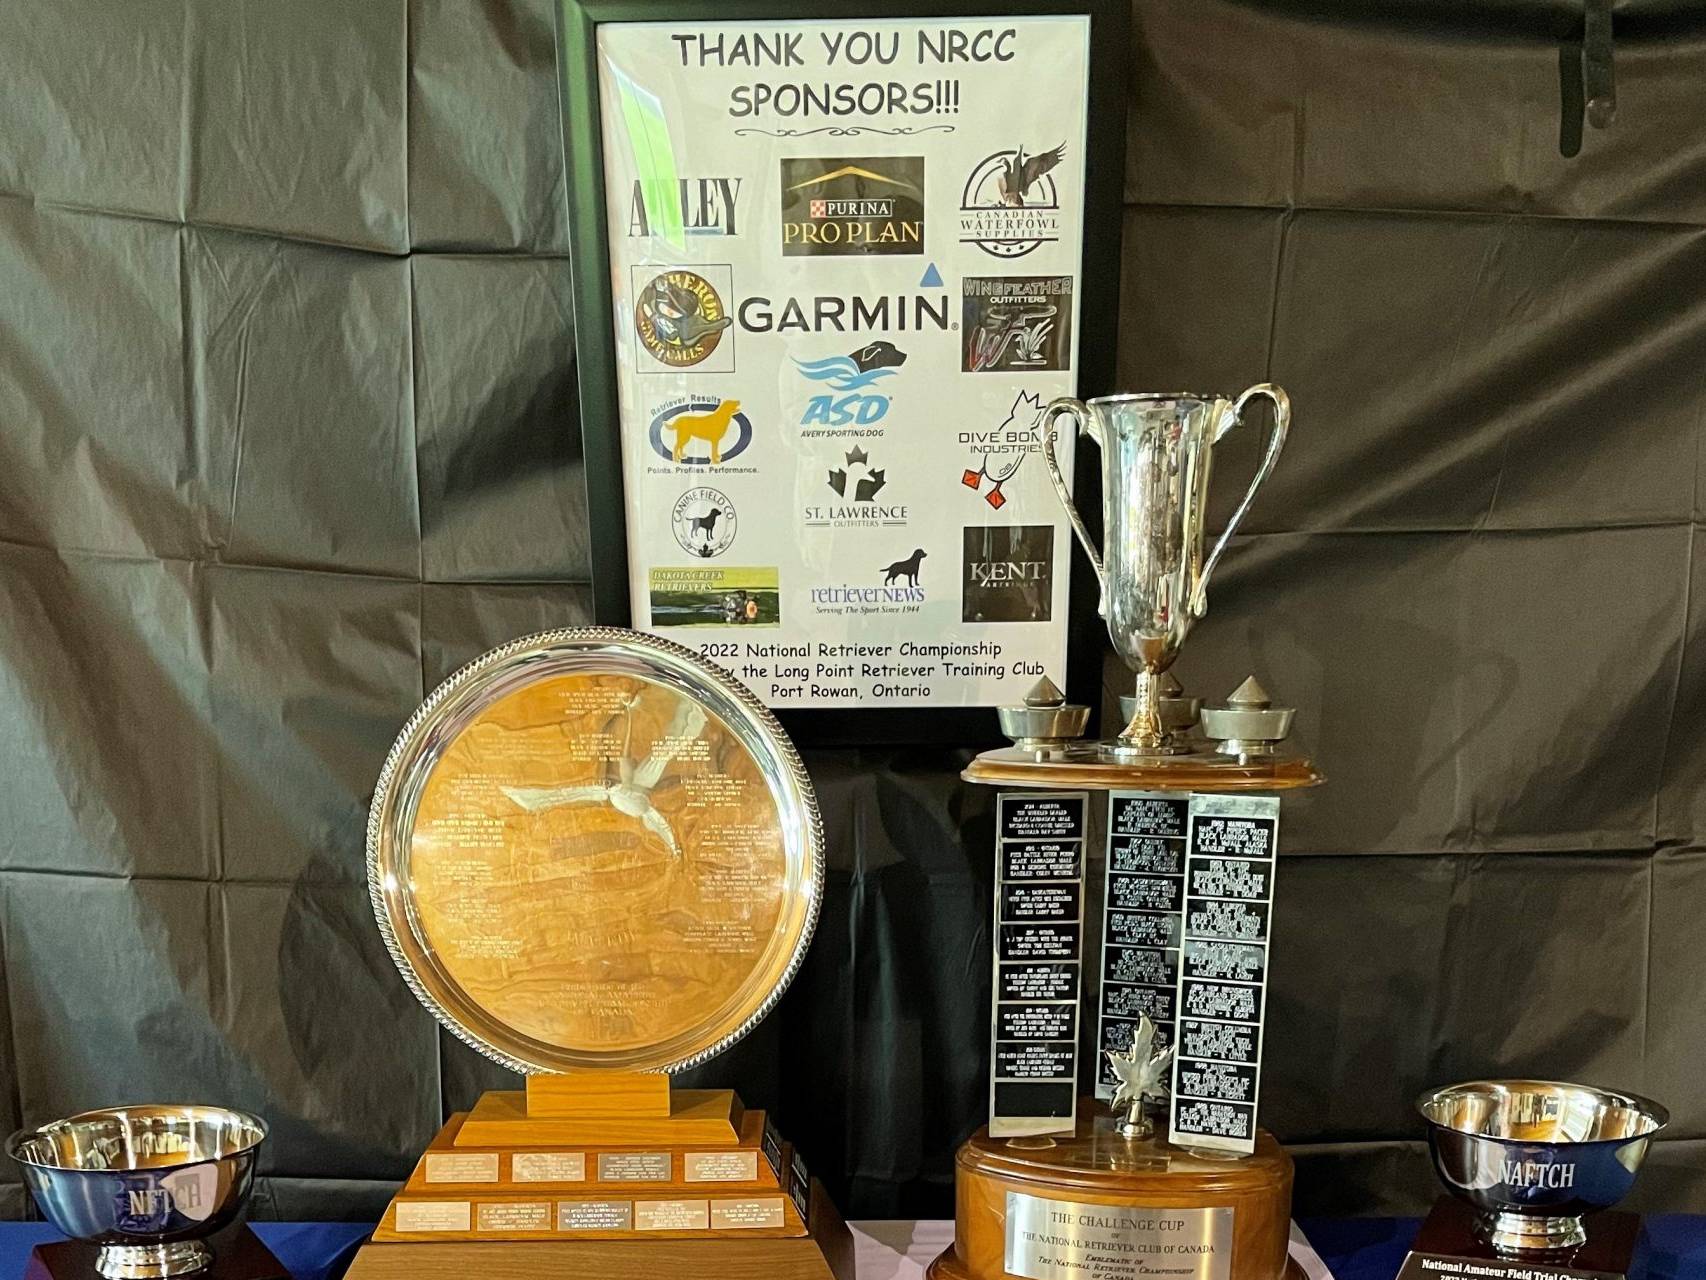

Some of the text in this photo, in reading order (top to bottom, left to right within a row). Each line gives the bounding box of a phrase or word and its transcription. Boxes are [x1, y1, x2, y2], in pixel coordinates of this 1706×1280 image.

[671, 29, 1016, 67] THANK YOU NRCC
[729, 80, 960, 117] SPONSORS!!!
[828, 202, 889, 215] PURINA
[976, 211, 1043, 219] CANADIAN
[783, 221, 921, 243] PRO PLAN
[961, 218, 1060, 230] WATERFOWL
[990, 296, 1047, 304] OUTFITTERS
[738, 295, 949, 333] GARMIN
[665, 344, 705, 361] CALLS
[650, 394, 722, 417] Retriever Results
[800, 393, 891, 426] ASD
[826, 429, 865, 437] SPORTING
[866, 429, 884, 437] DOG
[959, 432, 1000, 443] DIVE
[673, 489, 735, 523] CANINE FIELD CO
[805, 506, 908, 519] ST. LAWRENCE
[834, 520, 879, 528] OUTFITTERS
[654, 582, 712, 592] RETRIEVERS
[816, 606, 842, 616] Serving
[845, 606, 858, 614] The
[860, 606, 879, 614] Sport
[902, 605, 920, 613] 1944
[700, 641, 1002, 658] 2022 National Retriever Championship
[742, 664, 770, 678] the
[775, 663, 809, 681] Long
[816, 663, 855, 678] Point
[861, 663, 935, 677] Retriever
[942, 662, 1005, 680] Training
[1012, 661, 1045, 675] Club
[771, 683, 931, 700] Port Rowan, Ontario
[1498, 1161, 1575, 1188] NAFTCH
[1051, 1211, 1185, 1231] THE CHALLENGE CUP
[1022, 1231, 1215, 1254] THE NATIONAL RETRIEVER CLUB OF CANADA
[1422, 1258, 1463, 1273] National
[1464, 1264, 1506, 1278] Amateur
[1507, 1268, 1532, 1280] Field
